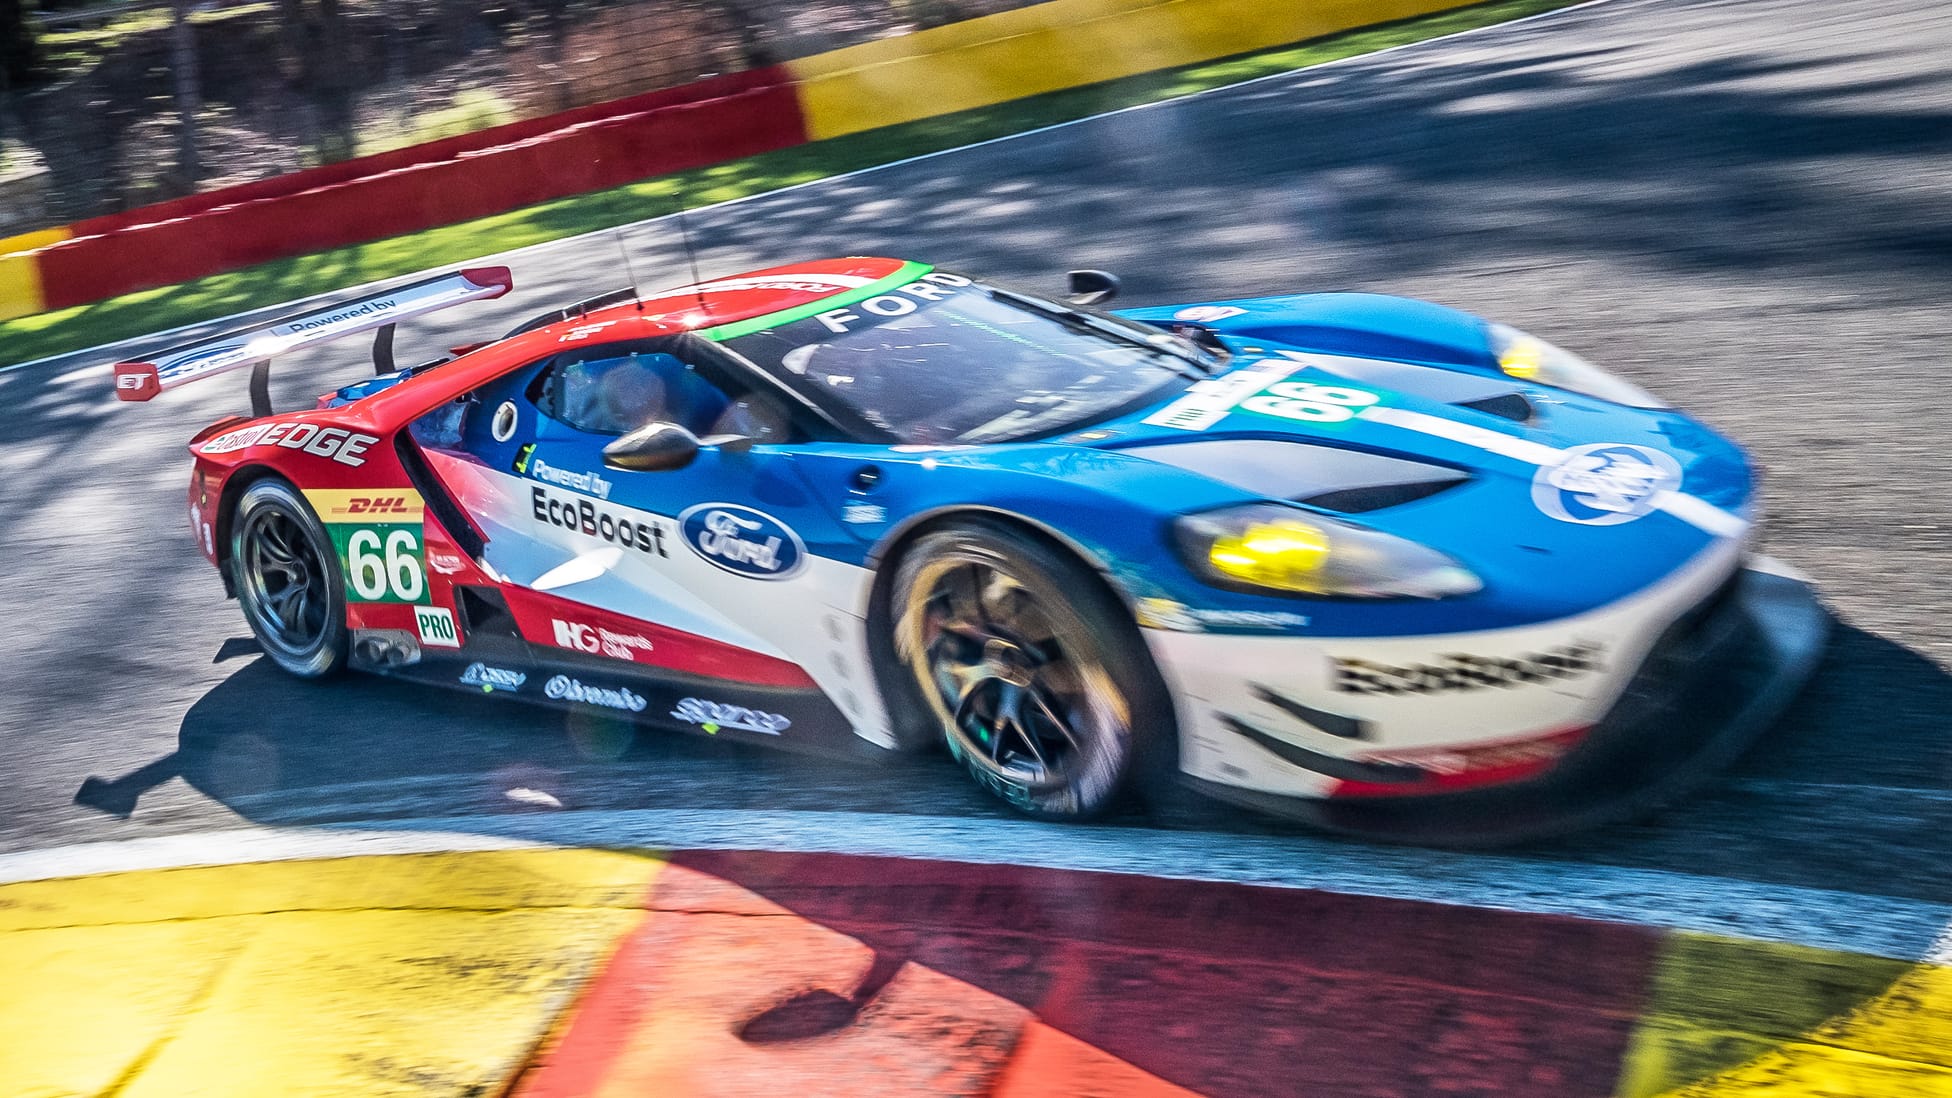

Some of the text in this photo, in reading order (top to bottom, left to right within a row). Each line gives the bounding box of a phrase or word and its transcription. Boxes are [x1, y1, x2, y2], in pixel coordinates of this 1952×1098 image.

[289, 304, 373, 333] Powered
[815, 273, 972, 333] FORD
[1239, 381, 1380, 423] 66
[255, 422, 381, 467] EDGE
[532, 458, 592, 492] Powered
[348, 497, 408, 513] DHL
[531, 485, 670, 559] EcoBoost
[698, 510, 783, 571] Ford
[348, 529, 423, 601] 66
[419, 612, 455, 640] PRO
